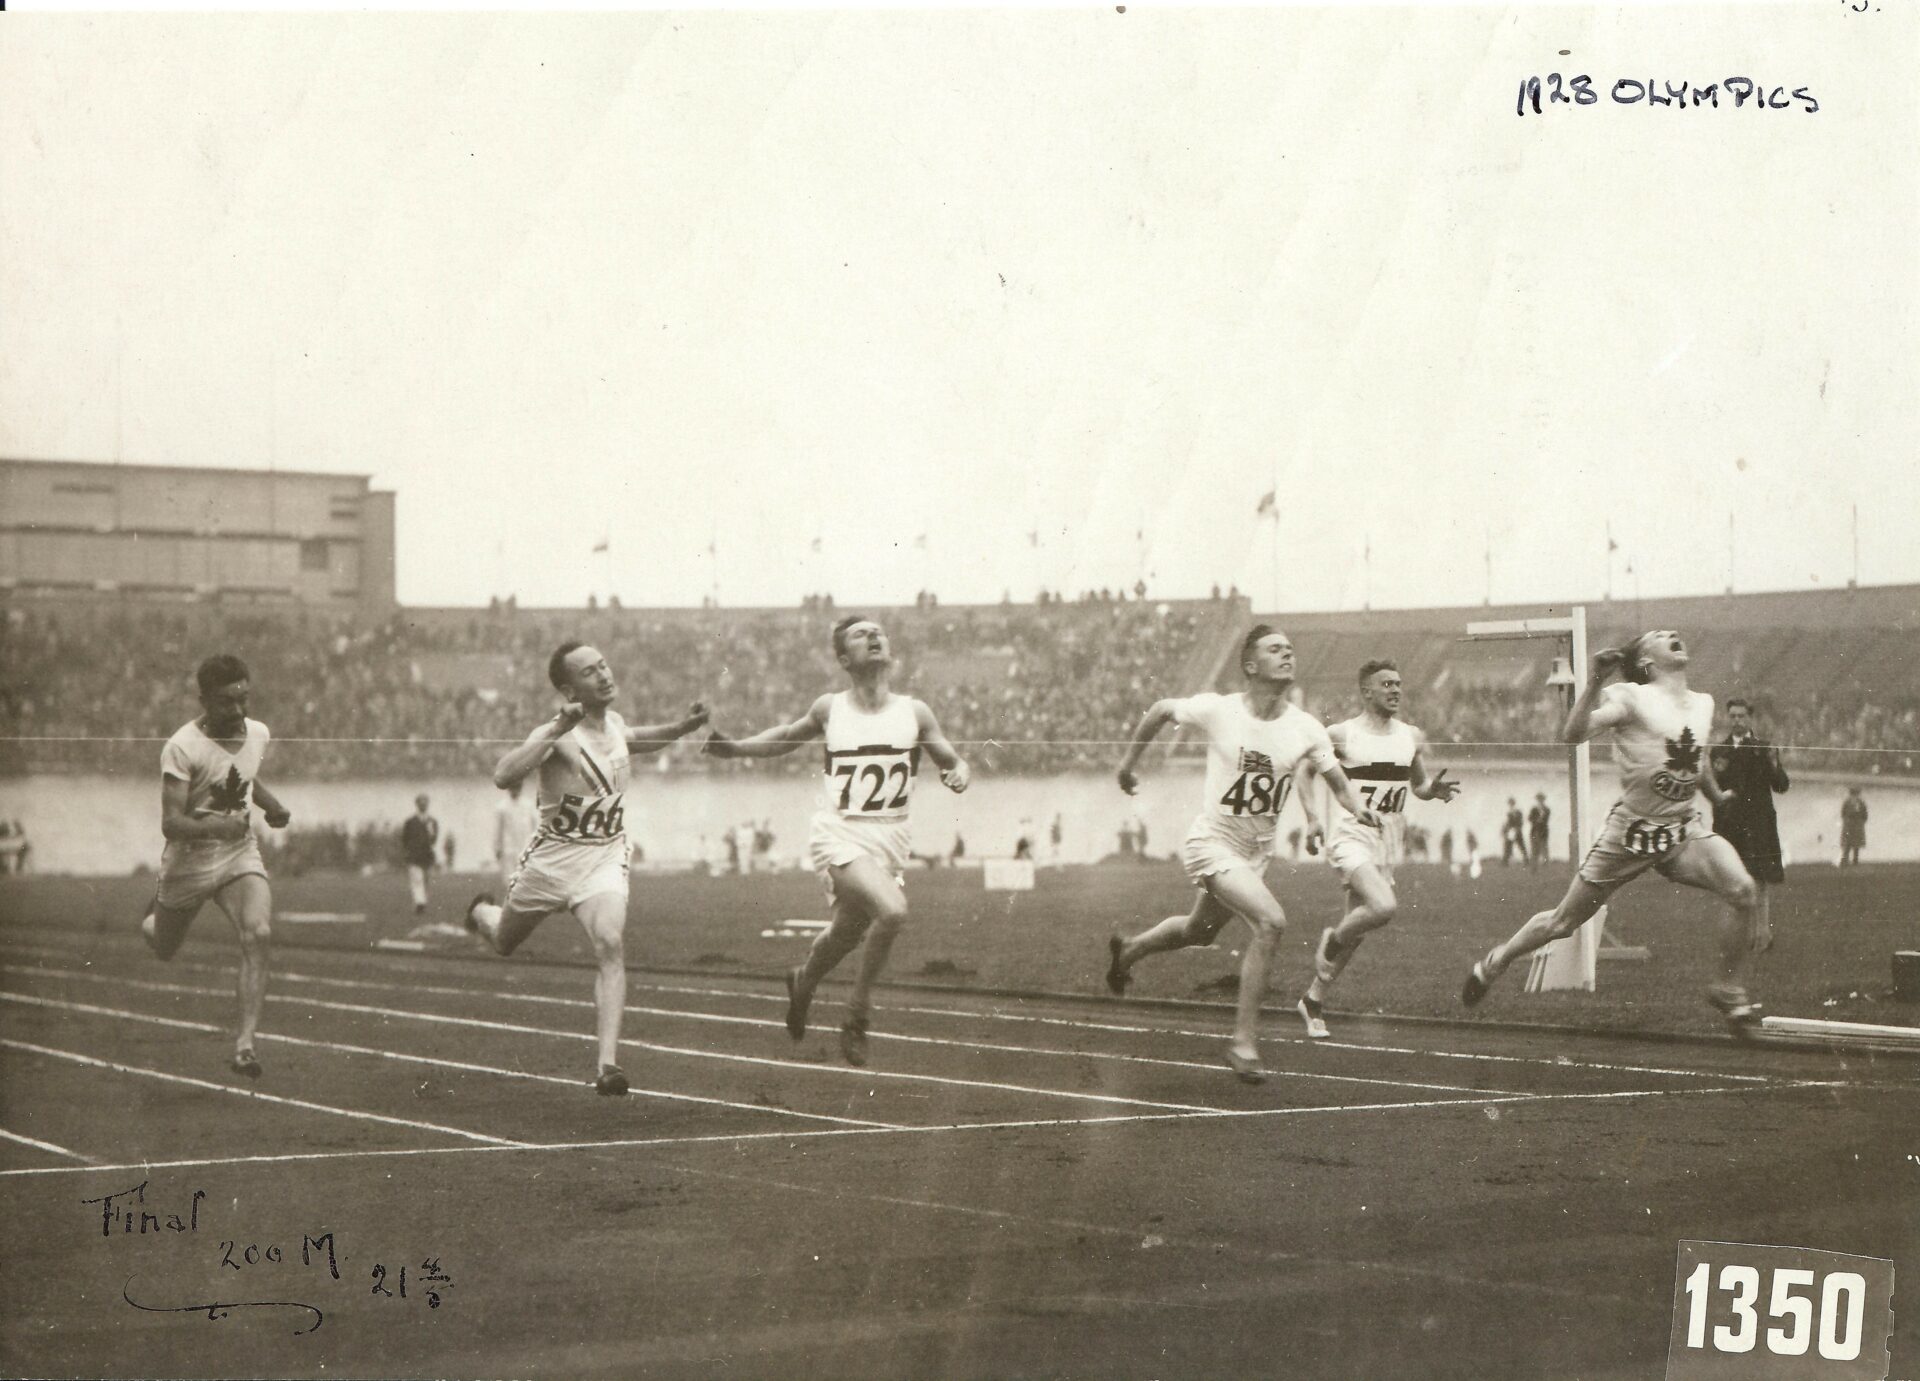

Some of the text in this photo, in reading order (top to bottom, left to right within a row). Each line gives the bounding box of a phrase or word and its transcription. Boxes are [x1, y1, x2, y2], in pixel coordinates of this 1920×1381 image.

[834, 761, 909, 812] 722
[1220, 772, 1292, 815] 480
[1360, 786, 1407, 814] 740
[551, 793, 624, 838] 566
